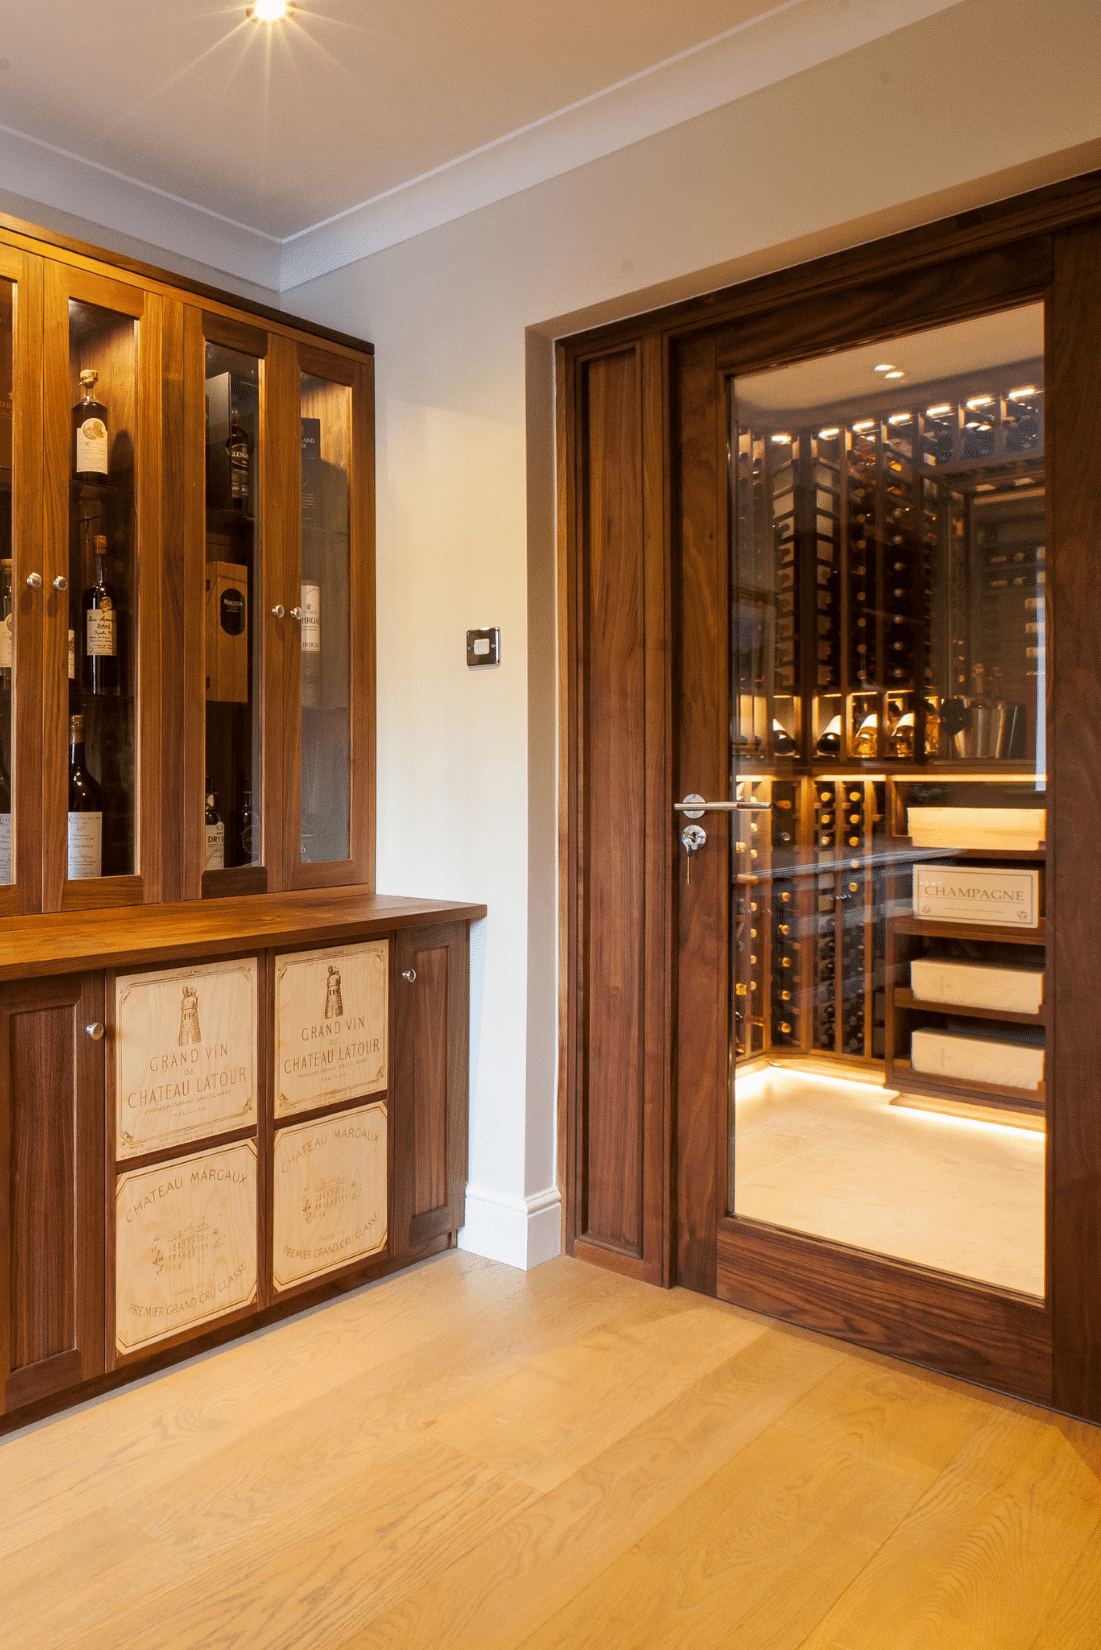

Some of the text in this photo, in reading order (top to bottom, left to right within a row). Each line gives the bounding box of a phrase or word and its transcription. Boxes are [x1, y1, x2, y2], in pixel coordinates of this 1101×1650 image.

[924, 886, 1024, 901] CHAMPAGNE
[302, 1016, 365, 1041] GRAND VIN
[150, 1042, 228, 1072] GRAND VIN
[184, 1068, 194, 1076] DE
[284, 1038, 380, 1074] CHATEAU LATOUR
[128, 1068, 247, 1108] CHATEAU LATOUR
[281, 1128, 380, 1174] CHATEAU MARGAUX
[126, 1169, 247, 1223] CHATEAU MARGAUX
[282, 1245, 312, 1260] PREMIER
[314, 1240, 339, 1259] GRAND
[340, 1234, 354, 1251] CRU
[356, 1210, 380, 1240] CLASSE
[128, 1303, 164, 1318] PREMIER
[166, 1297, 198, 1316] GRAND
[200, 1286, 216, 1304] CRU
[218, 1262, 247, 1292] CLASSE
